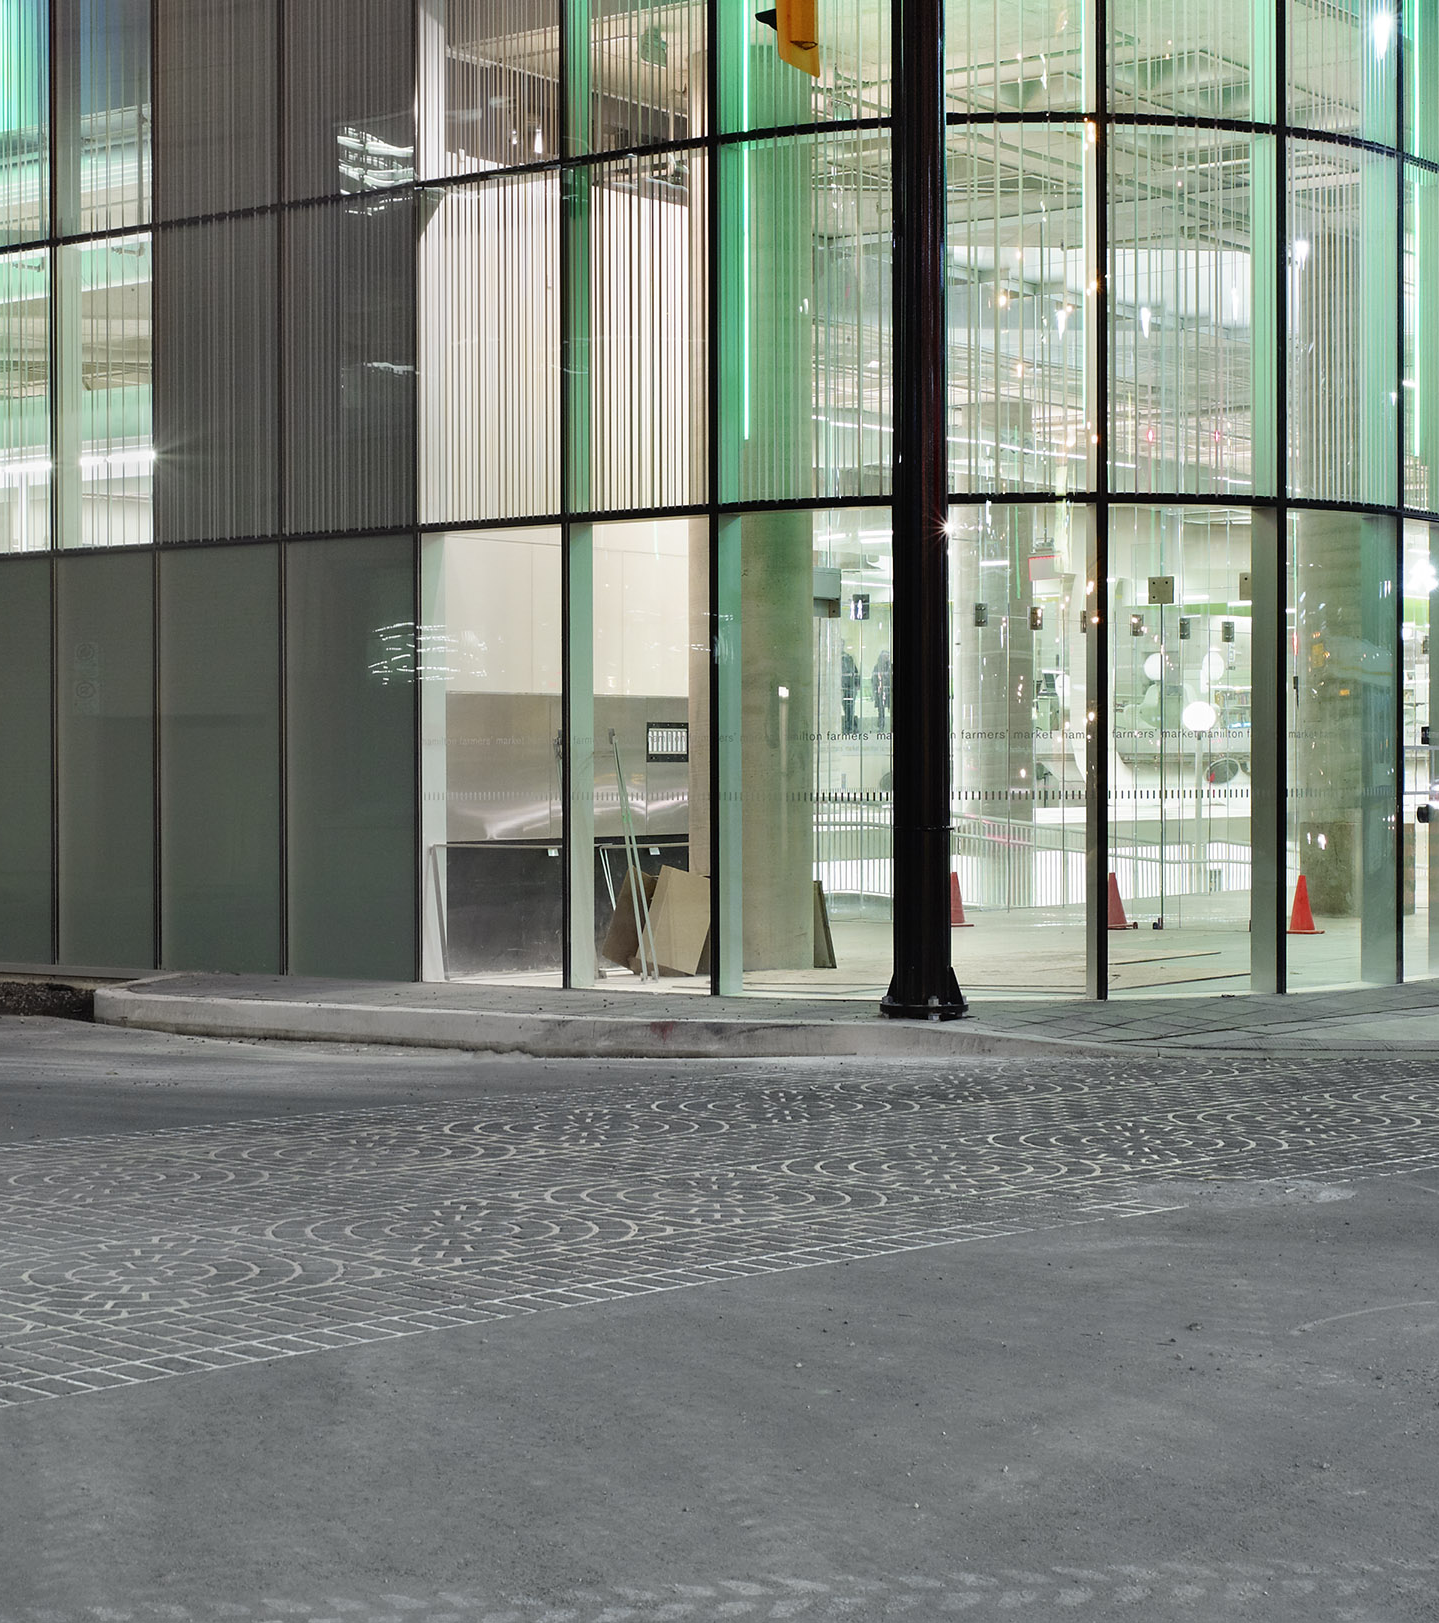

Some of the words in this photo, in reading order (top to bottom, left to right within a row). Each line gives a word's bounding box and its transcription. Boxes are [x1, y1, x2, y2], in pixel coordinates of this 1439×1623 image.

[826, 730, 872, 741] farmers'
[961, 729, 1008, 740] farmers'
[1013, 729, 1054, 739] market
